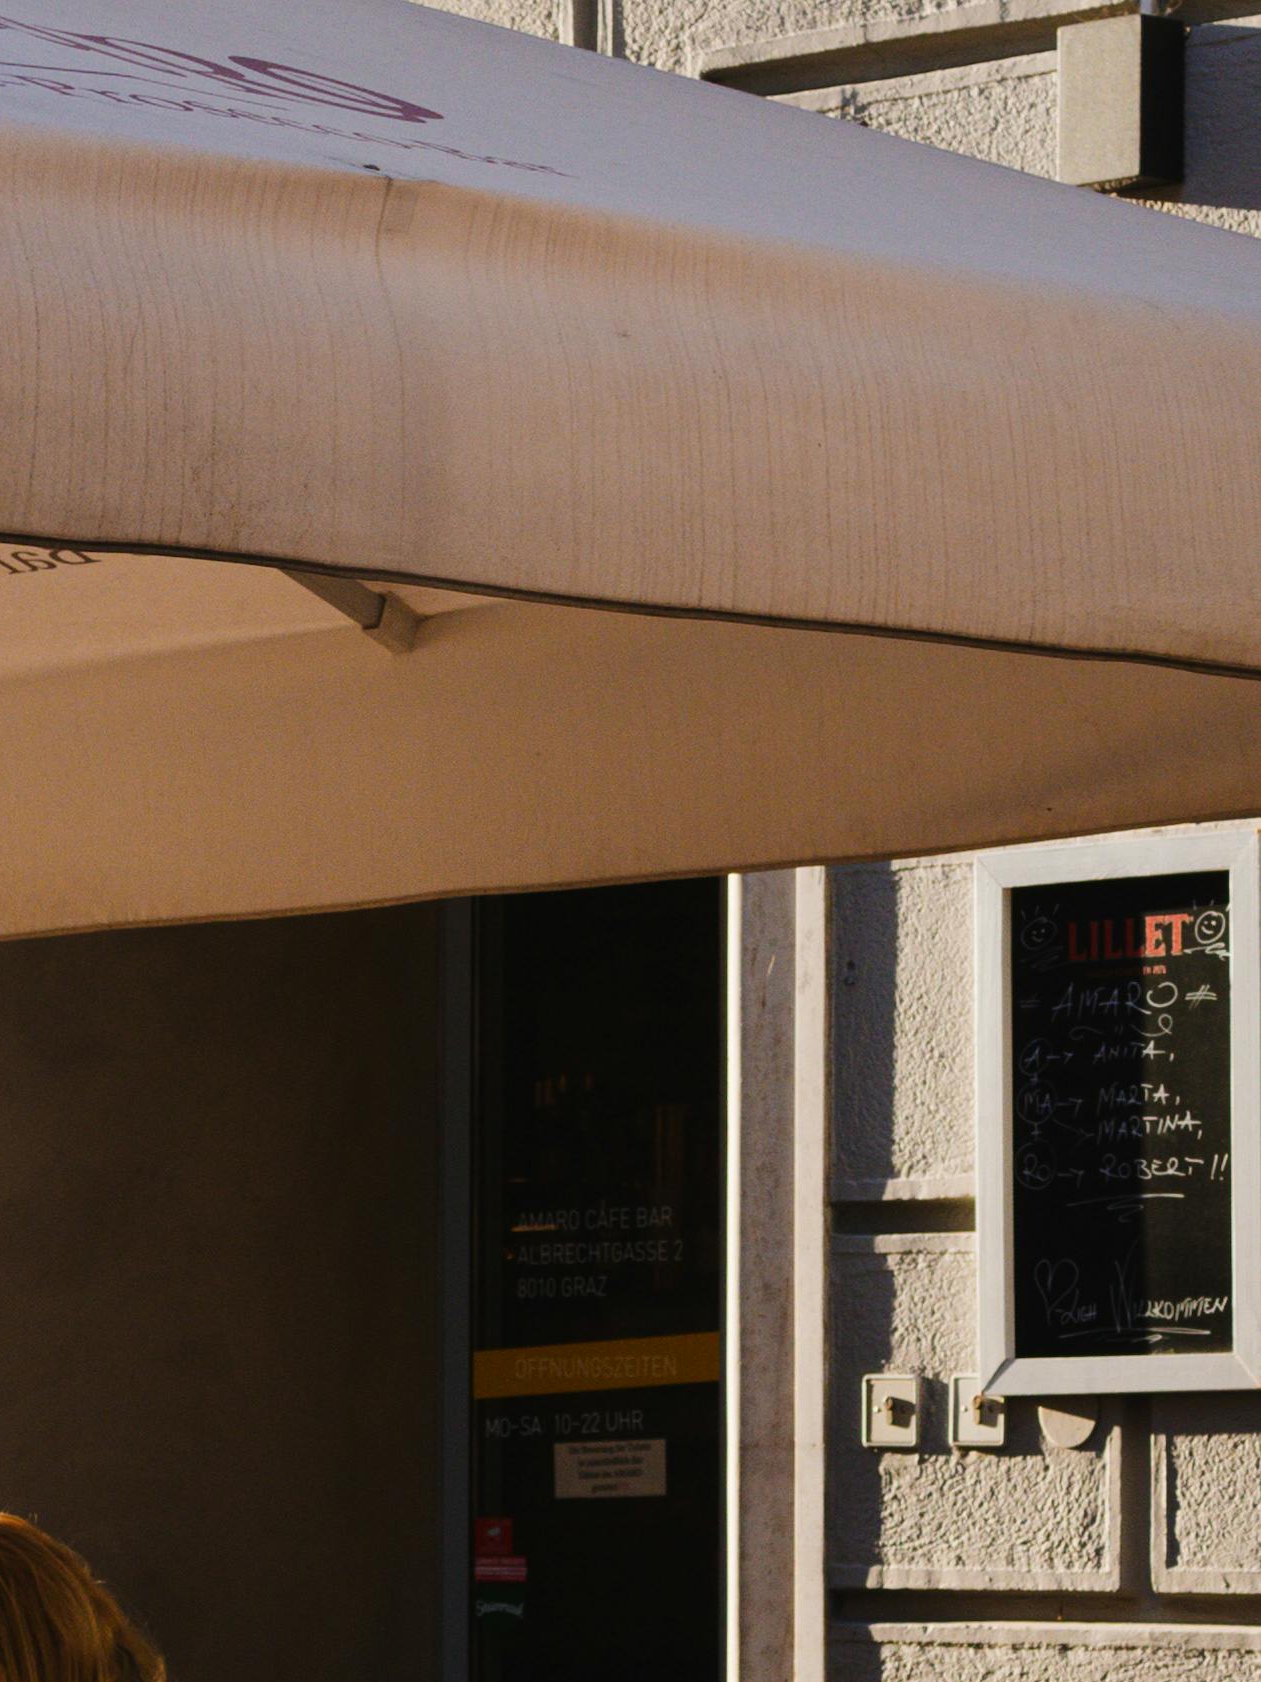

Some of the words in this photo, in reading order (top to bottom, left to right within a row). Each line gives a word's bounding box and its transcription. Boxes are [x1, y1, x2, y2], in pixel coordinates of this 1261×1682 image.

[1065, 913, 1193, 961] LILLET
[1051, 980, 1178, 1022] AMARO
[635, 1206, 674, 1229] BAR
[517, 1240, 668, 1264] ALBRECHTGASSE
[516, 1276, 557, 1299] 8010
[561, 1274, 608, 1297] GRAZ
[554, 1412, 600, 1435] 10-22
[605, 1410, 644, 1432] UHR
